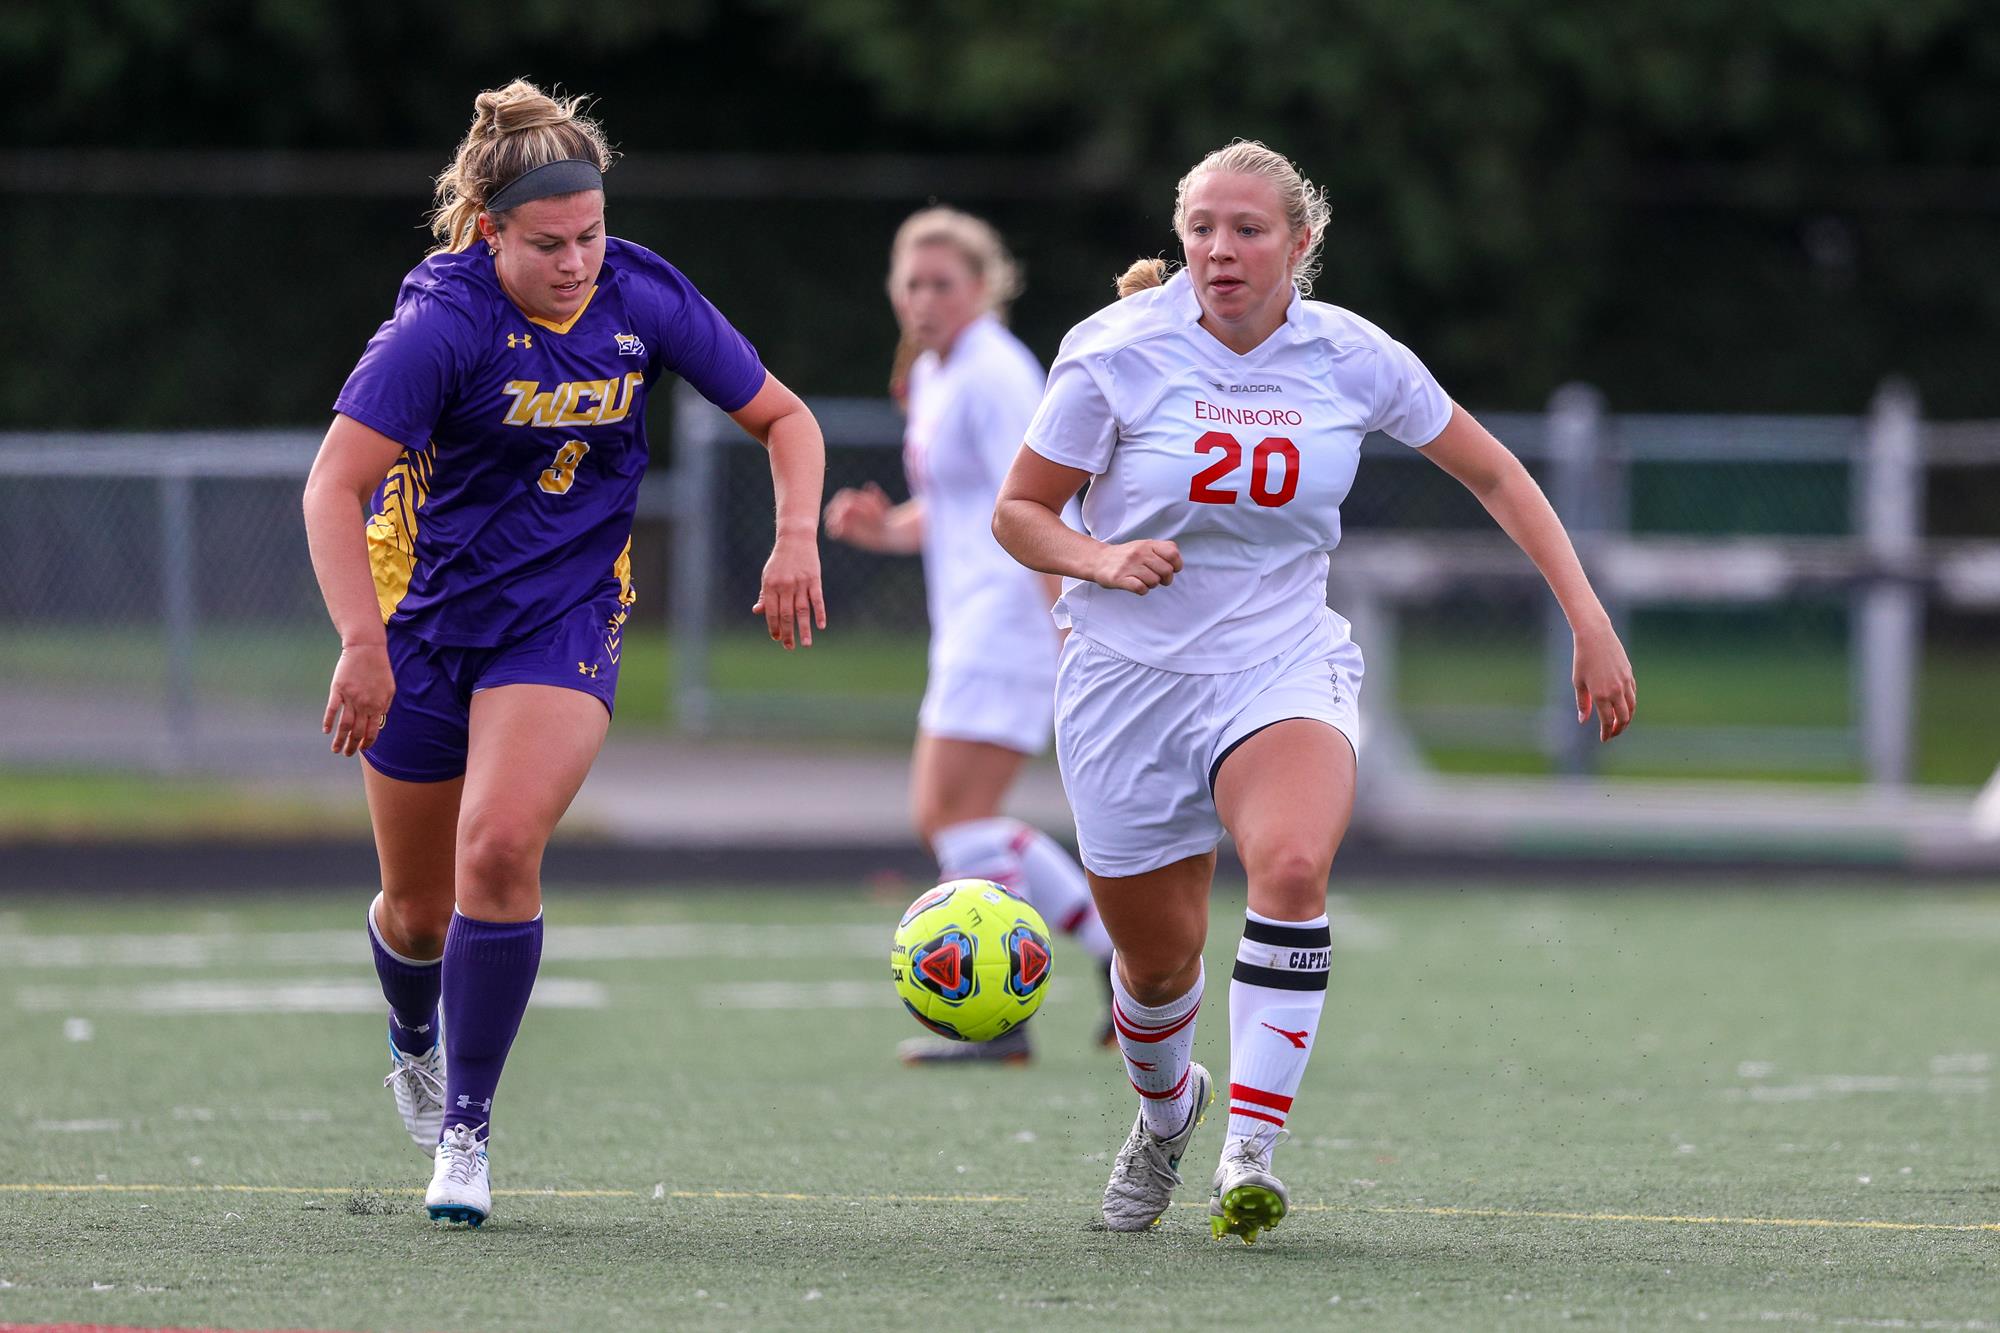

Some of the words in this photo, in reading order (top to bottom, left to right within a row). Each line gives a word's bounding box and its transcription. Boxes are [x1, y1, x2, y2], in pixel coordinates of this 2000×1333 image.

[502, 370, 643, 427] WCU
[1230, 384, 1282, 393] DIADORA
[1195, 400, 1302, 426] EDINBORO
[1188, 430, 1300, 508] 20
